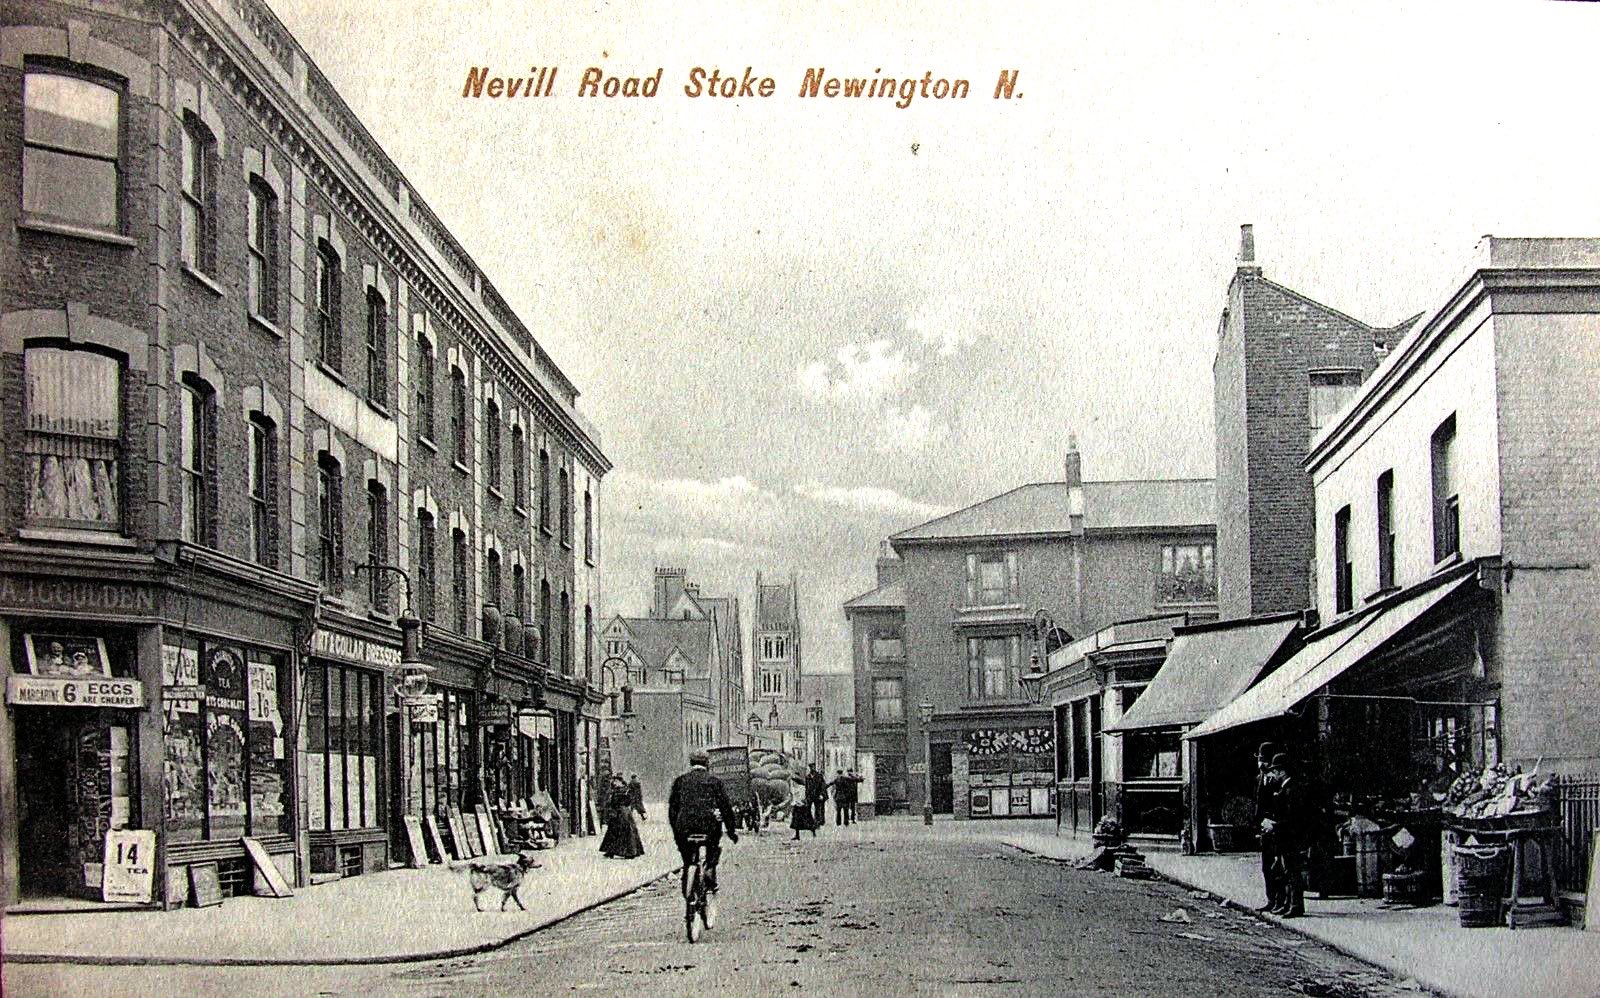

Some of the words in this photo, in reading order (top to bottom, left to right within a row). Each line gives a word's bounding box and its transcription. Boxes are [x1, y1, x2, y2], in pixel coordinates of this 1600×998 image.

[336, 634, 364, 661] COLLAR
[258, 667, 275, 691] Tea
[63, 682, 77, 704] 6
[88, 682, 134, 696] EGGS
[82, 696, 98, 704] ARE
